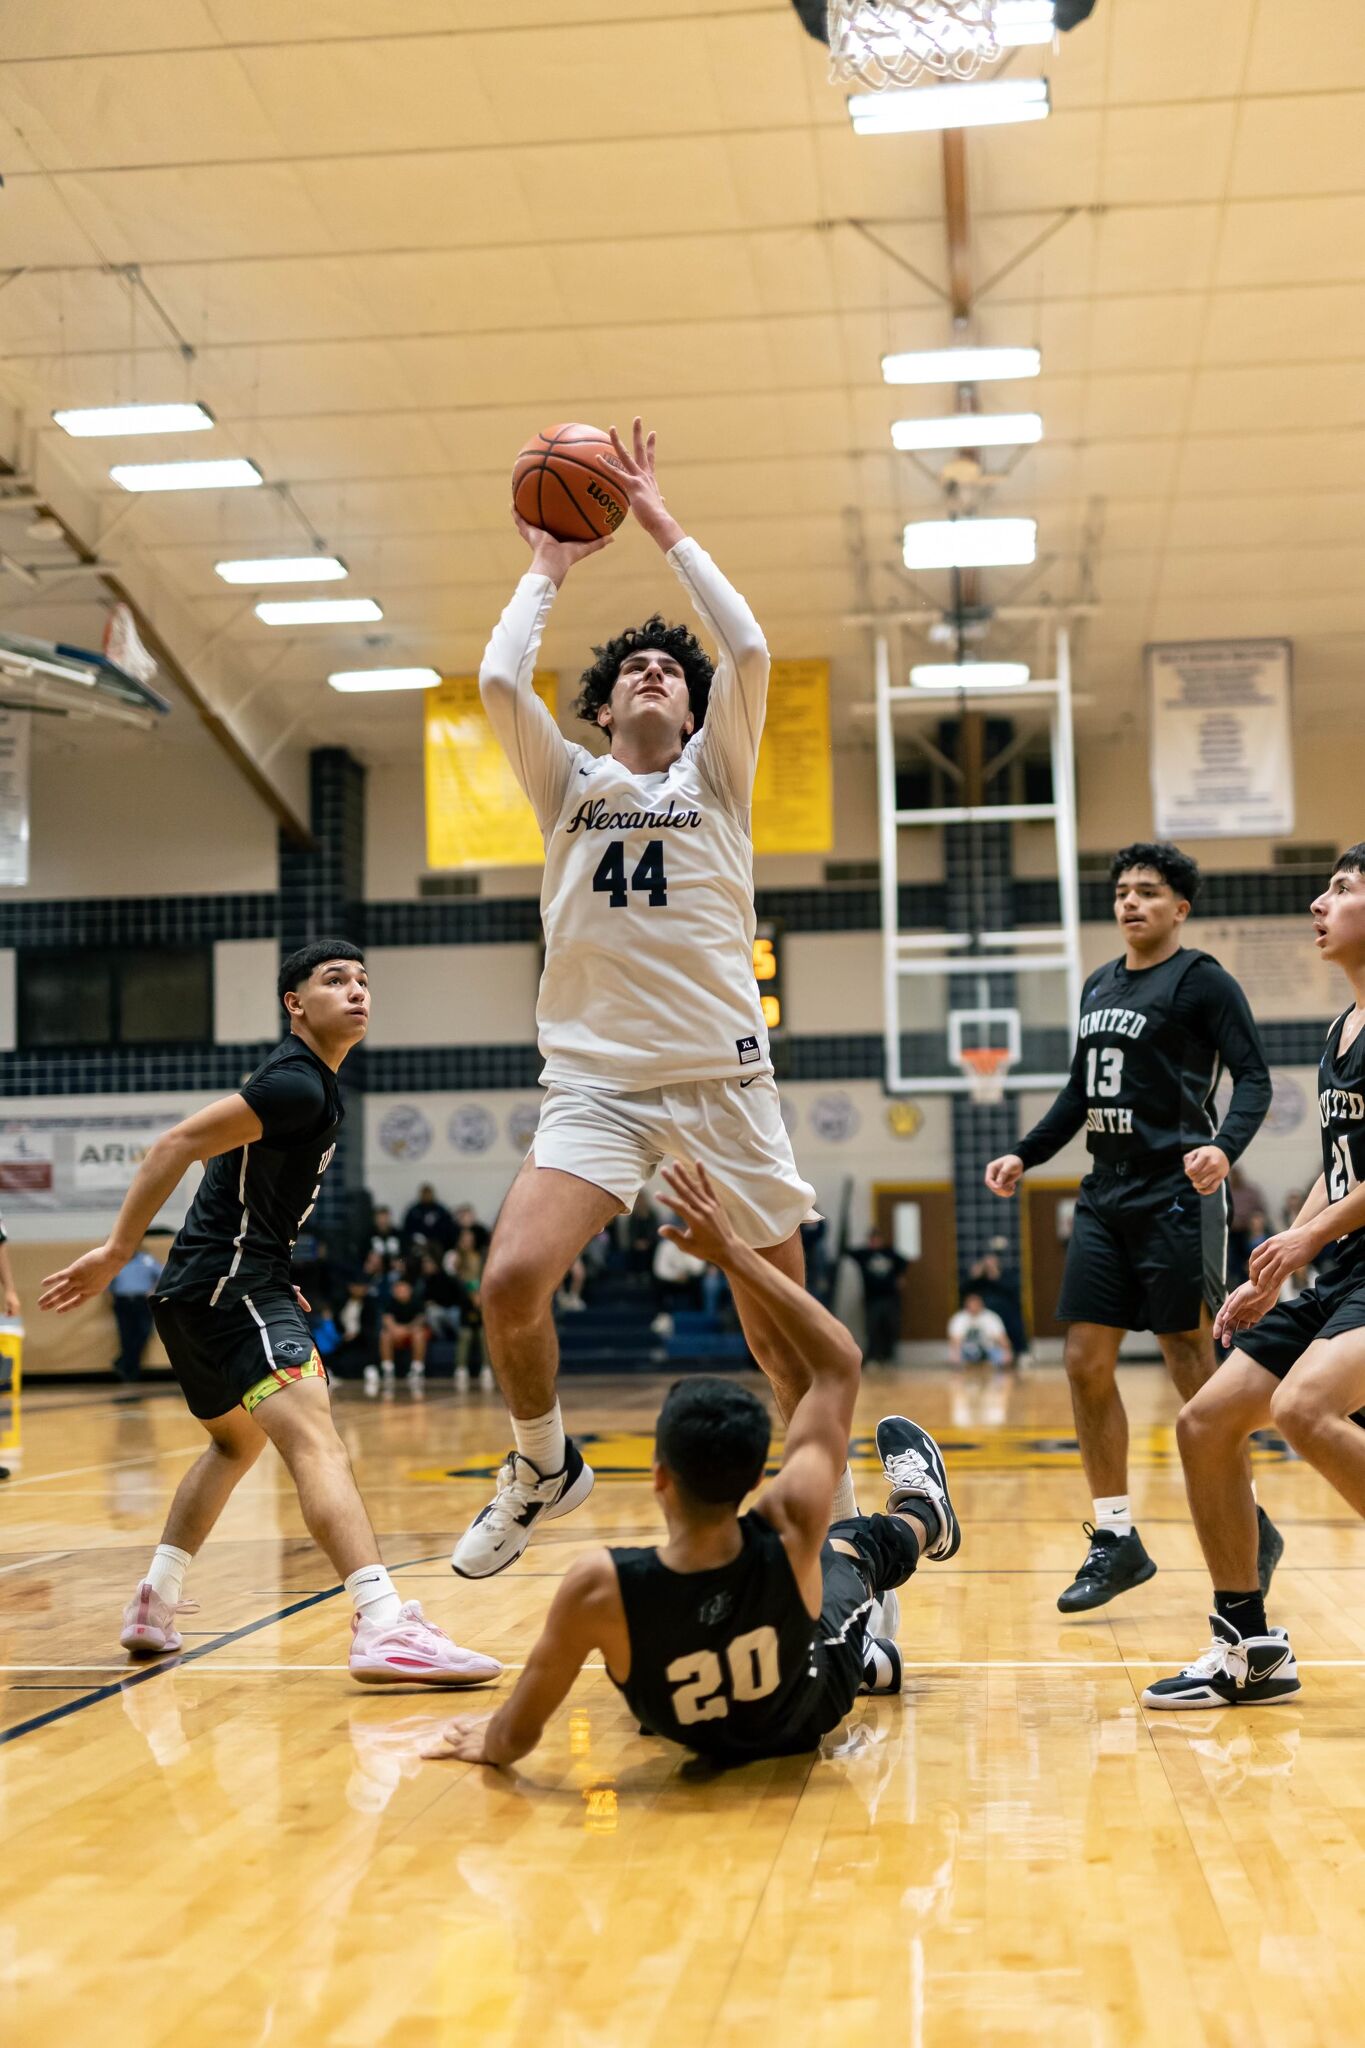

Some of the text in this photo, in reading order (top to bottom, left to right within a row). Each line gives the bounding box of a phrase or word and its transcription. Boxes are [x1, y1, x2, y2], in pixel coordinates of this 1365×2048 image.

[566, 798, 702, 833] Alexander
[592, 840, 668, 907] 44
[741, 1040, 754, 1049] XL
[1079, 1008, 1147, 1039] UNITED
[1086, 1047, 1124, 1097] 13
[1330, 1134, 1361, 1201] 21
[666, 1625, 782, 1725] 20
